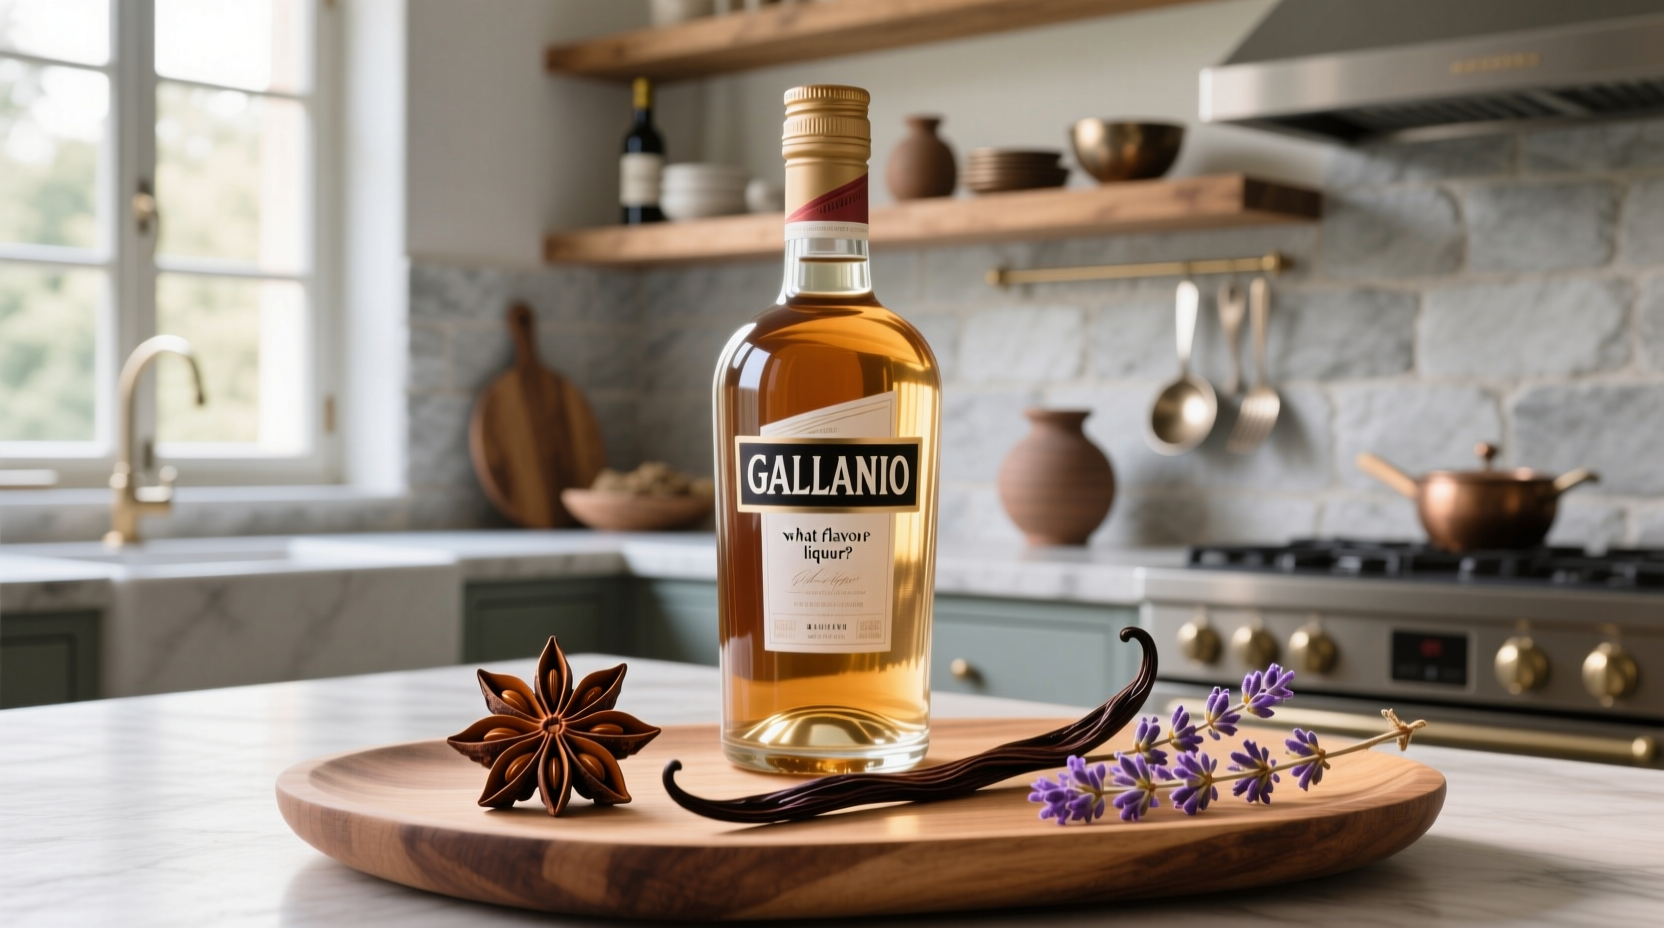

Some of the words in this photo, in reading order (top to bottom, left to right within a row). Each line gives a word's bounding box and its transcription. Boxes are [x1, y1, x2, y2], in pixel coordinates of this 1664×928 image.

[747, 454, 910, 496] GALLANIO
[782, 527, 818, 543] what
[804, 545, 853, 564] liquur?
